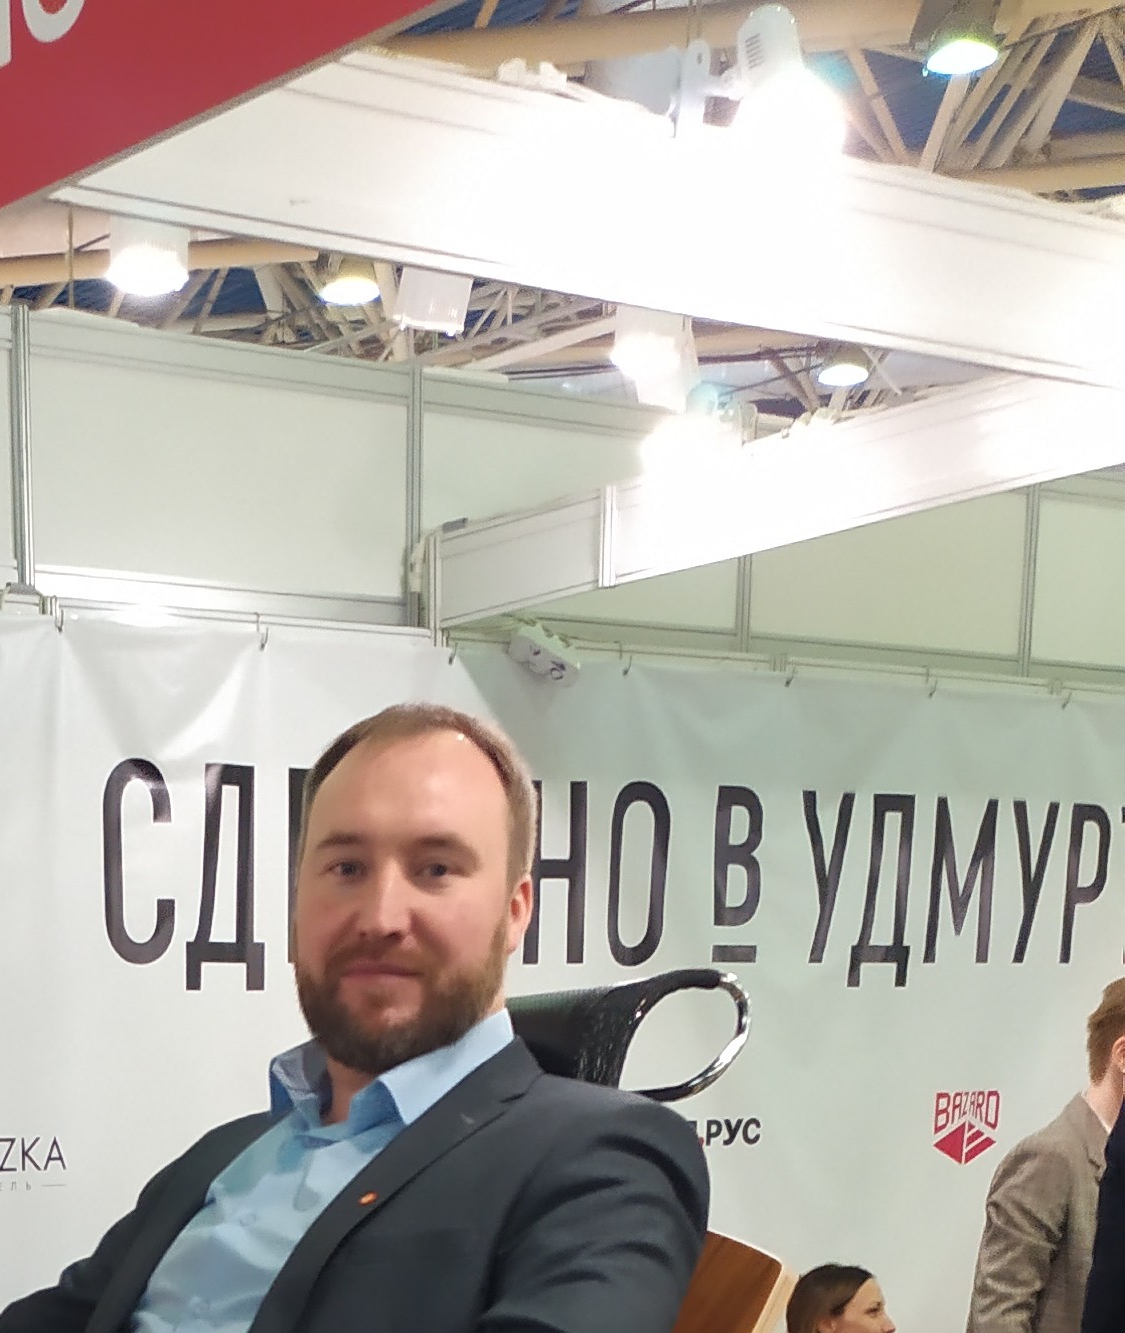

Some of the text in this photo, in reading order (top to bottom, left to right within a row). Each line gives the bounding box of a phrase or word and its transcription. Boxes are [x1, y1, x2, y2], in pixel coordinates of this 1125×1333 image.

[102, 757, 1125, 992] СДНО В УДМУР
